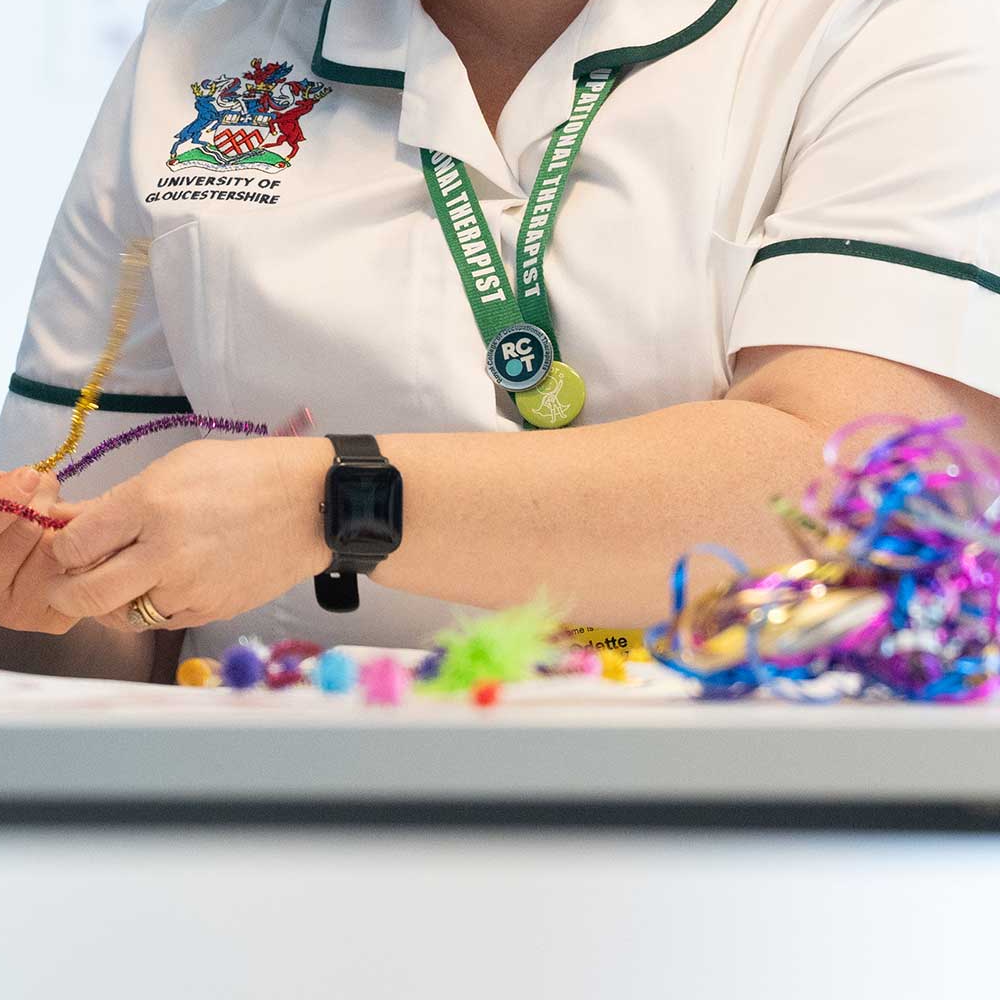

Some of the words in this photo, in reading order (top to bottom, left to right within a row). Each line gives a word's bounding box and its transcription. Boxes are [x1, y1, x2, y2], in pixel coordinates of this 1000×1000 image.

[145, 190, 280, 204] GLOUCESTERSHIRE
[157, 176, 255, 187] UNIVERSITY
[258, 179, 281, 189] OF
[446, 191, 506, 304] THERAPIST
[523, 174, 562, 298] THERAPIST
